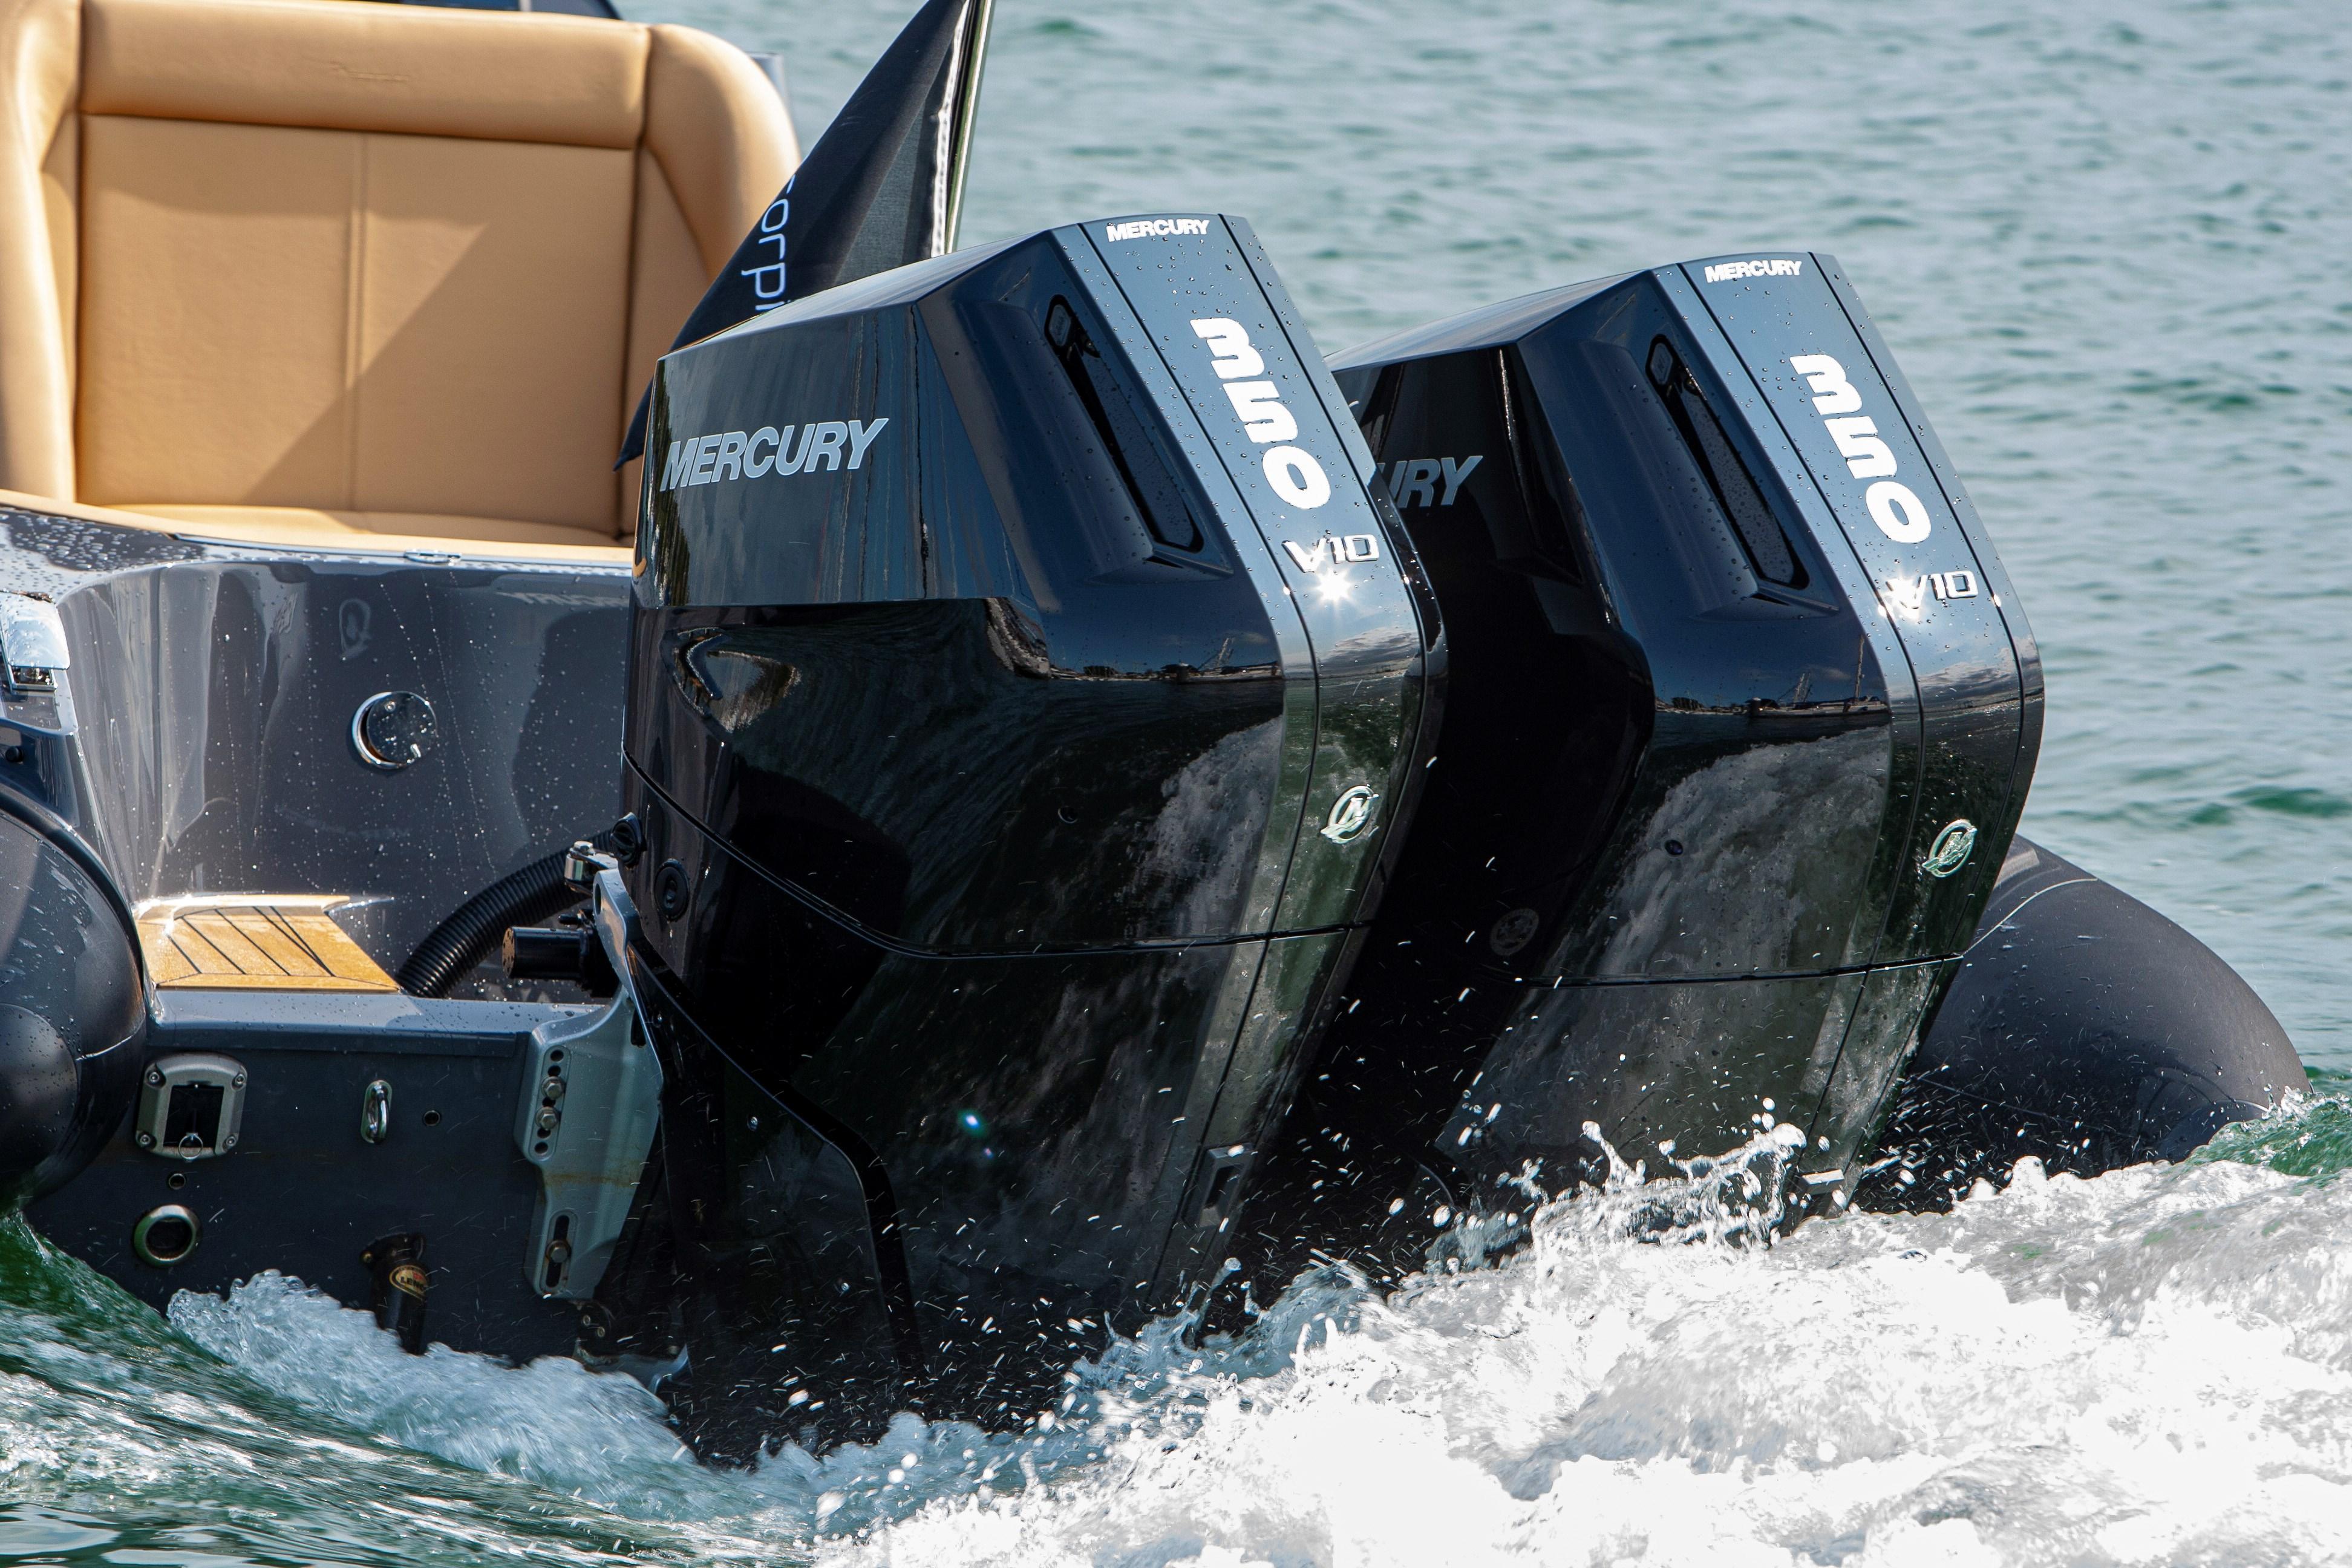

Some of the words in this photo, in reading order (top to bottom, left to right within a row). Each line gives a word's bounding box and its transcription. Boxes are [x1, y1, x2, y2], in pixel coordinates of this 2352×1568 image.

[1106, 218, 1210, 243] MERCURY
[1704, 259, 1802, 284] MERCURY
[1189, 317, 1331, 510] 350
[659, 417, 889, 492] MERCURY
[1789, 353, 1932, 543] 350
[1281, 534, 1380, 573] V10
[1885, 570, 1979, 610] V10
